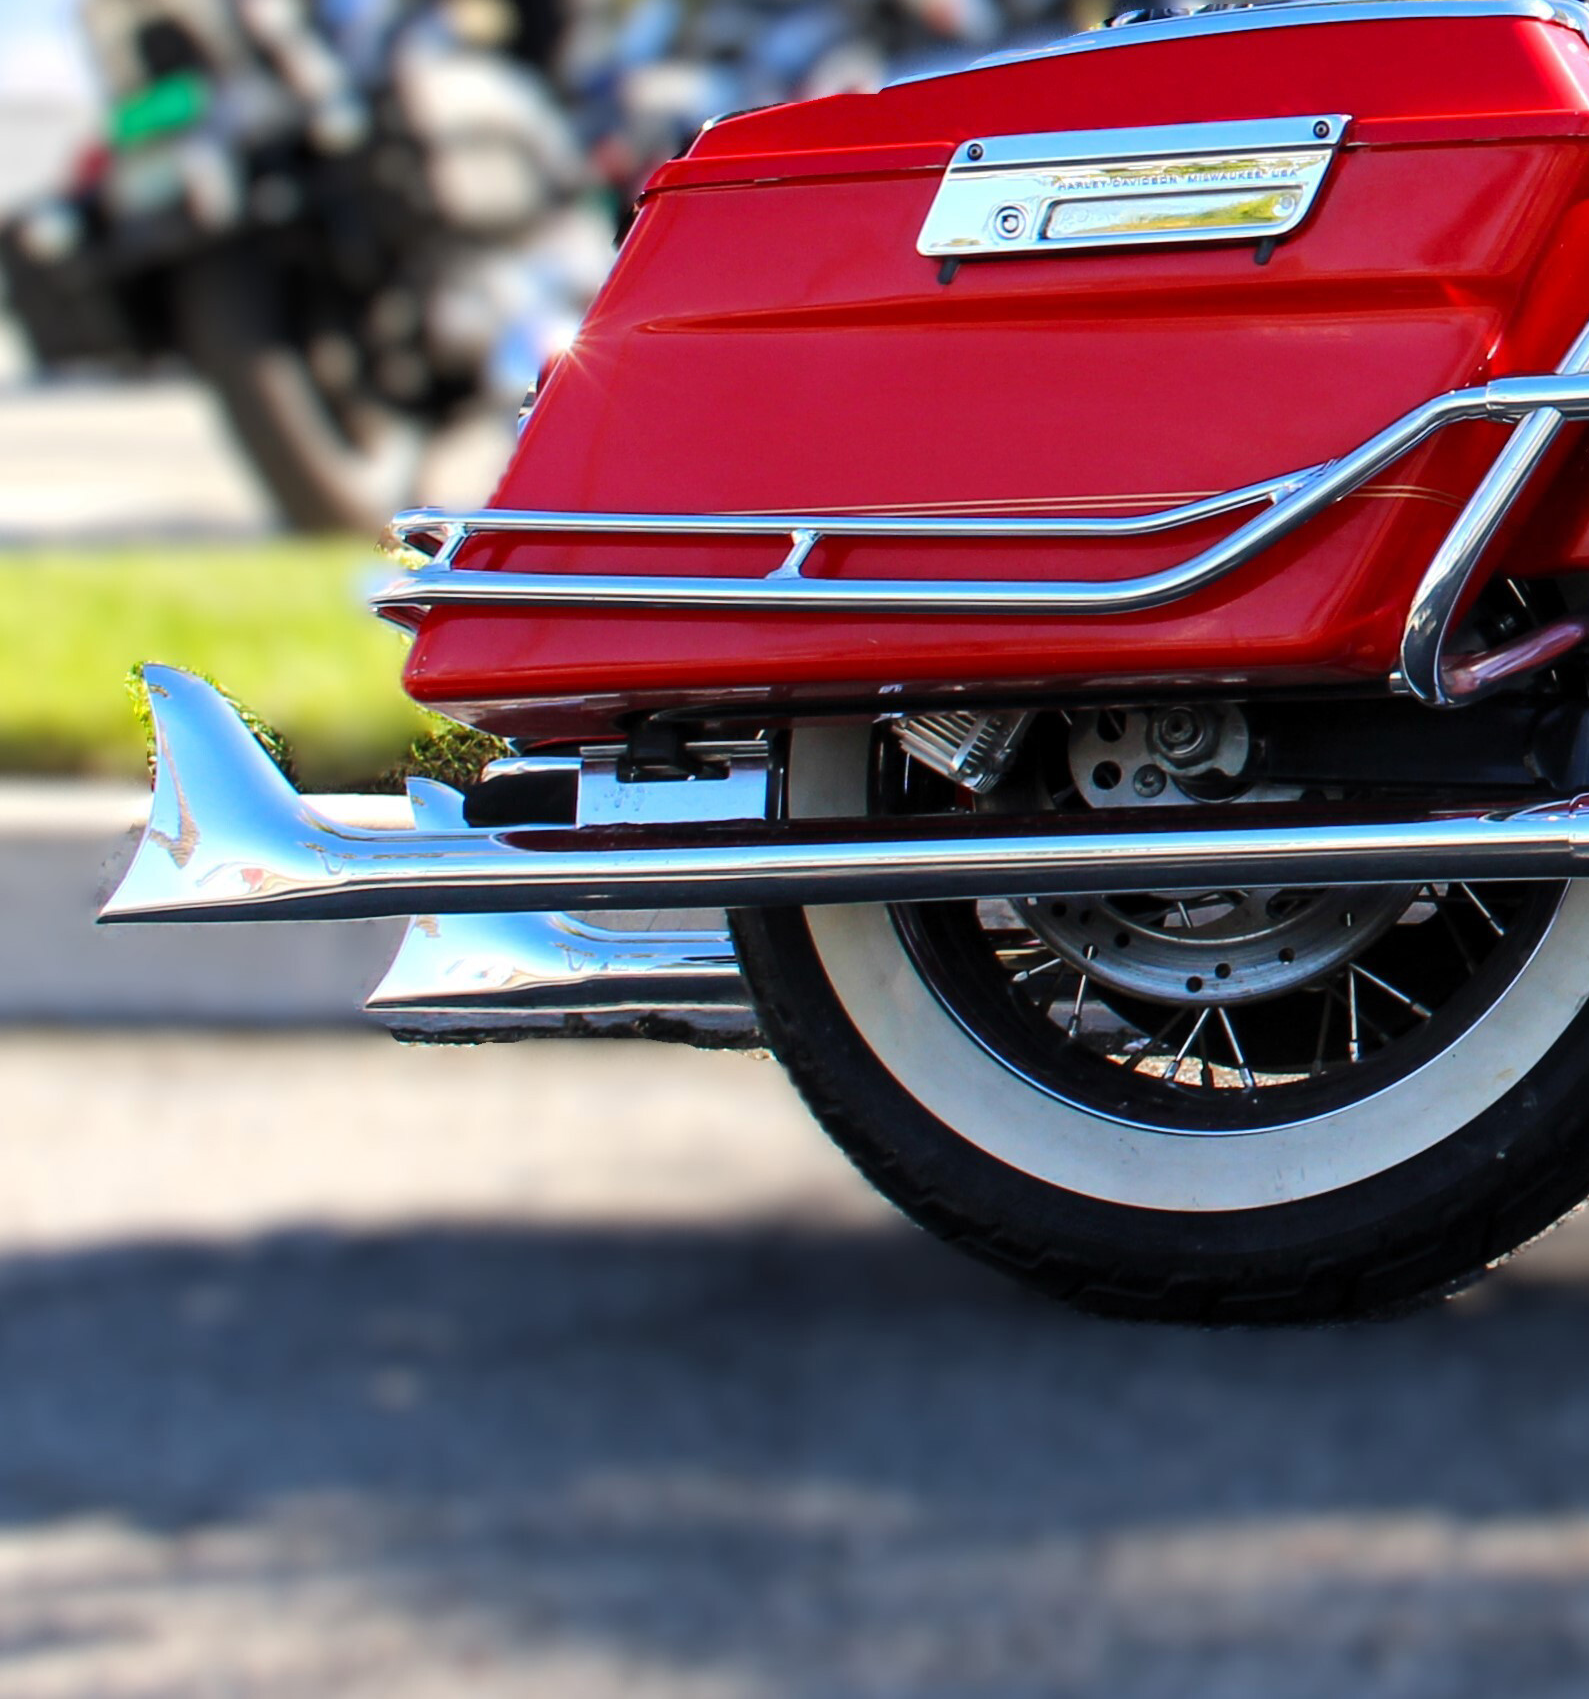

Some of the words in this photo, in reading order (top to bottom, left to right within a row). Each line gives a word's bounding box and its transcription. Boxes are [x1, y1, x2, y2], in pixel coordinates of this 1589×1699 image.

[1057, 175, 1179, 191] HARLEY-DAVIDSON
[1187, 169, 1263, 183] MILWAUKEE
[1271, 168, 1298, 179] USA
